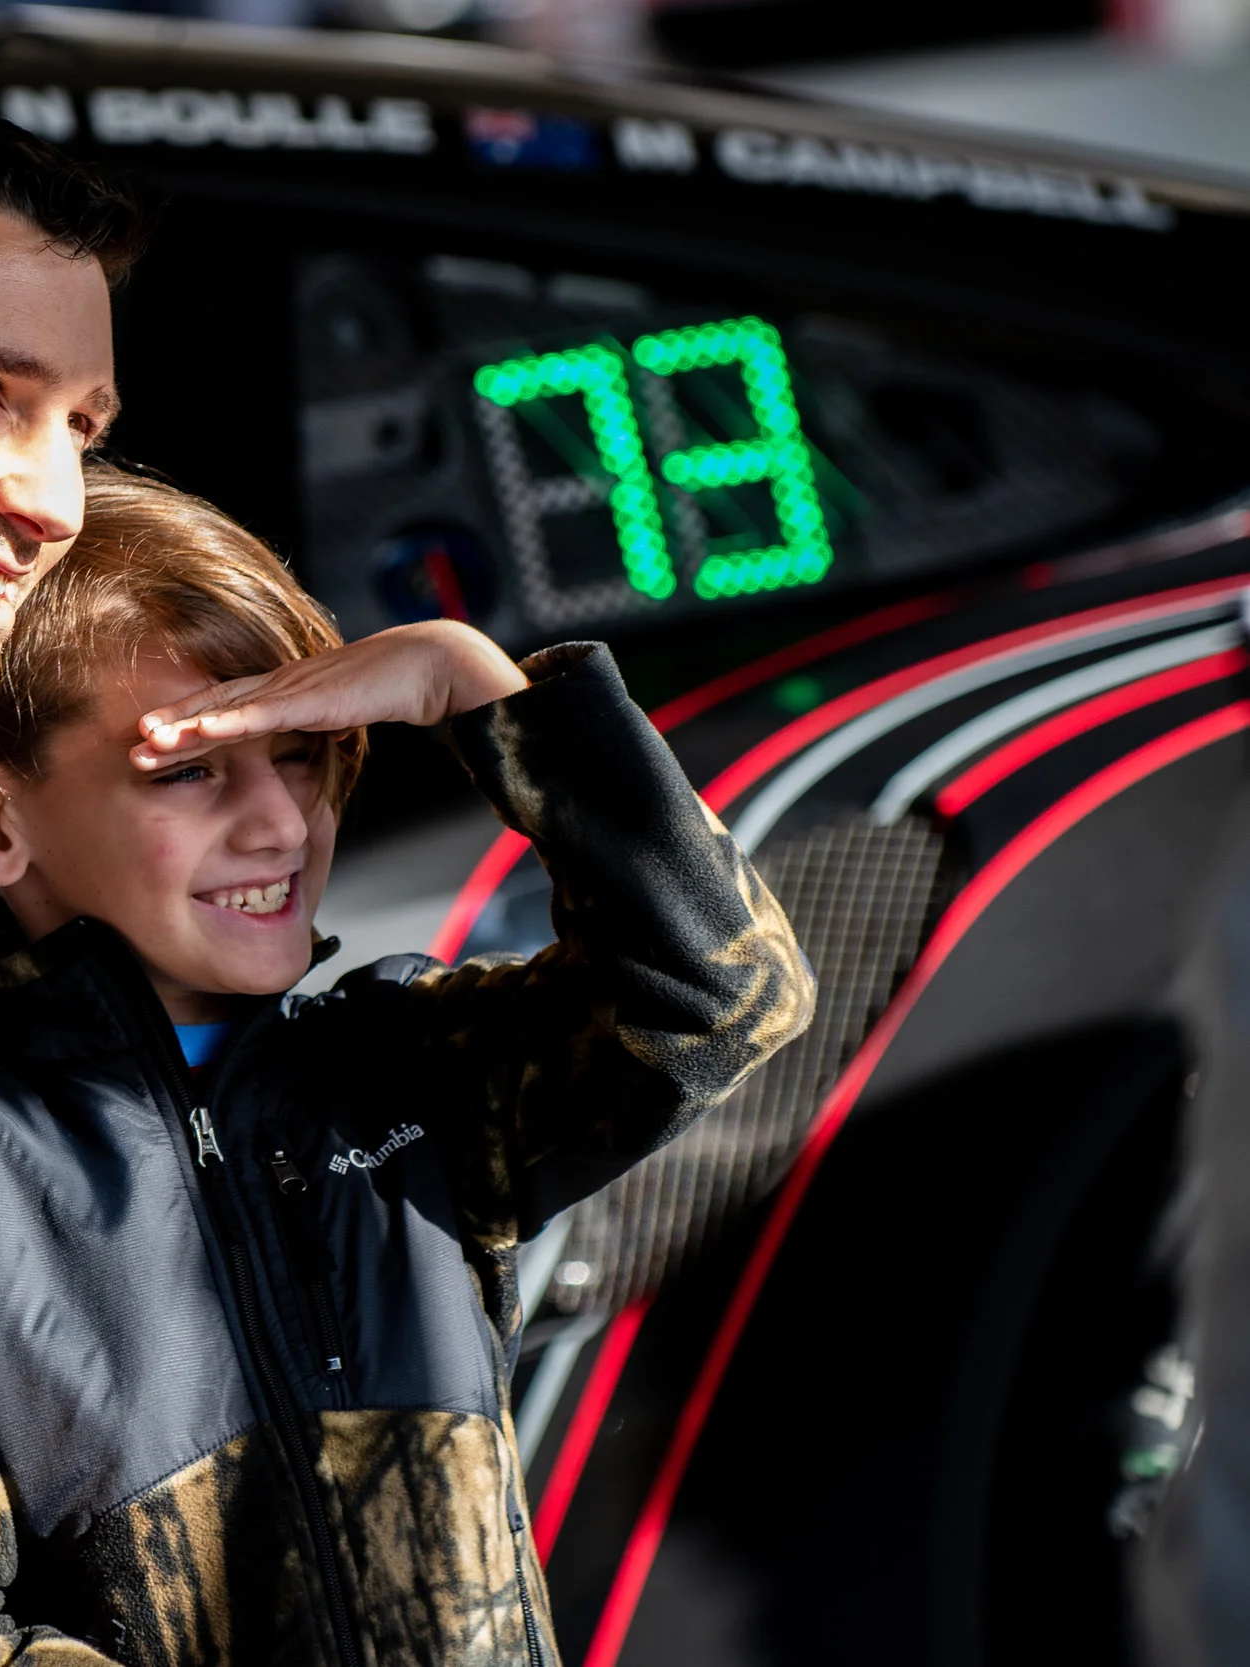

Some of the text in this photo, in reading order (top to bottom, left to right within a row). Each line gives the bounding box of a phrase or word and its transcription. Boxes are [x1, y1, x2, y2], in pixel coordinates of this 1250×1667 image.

[0, 85, 437, 155] N BOULLE
[611, 116, 1176, 231] M CAMPBELL
[473, 314, 833, 600] 73
